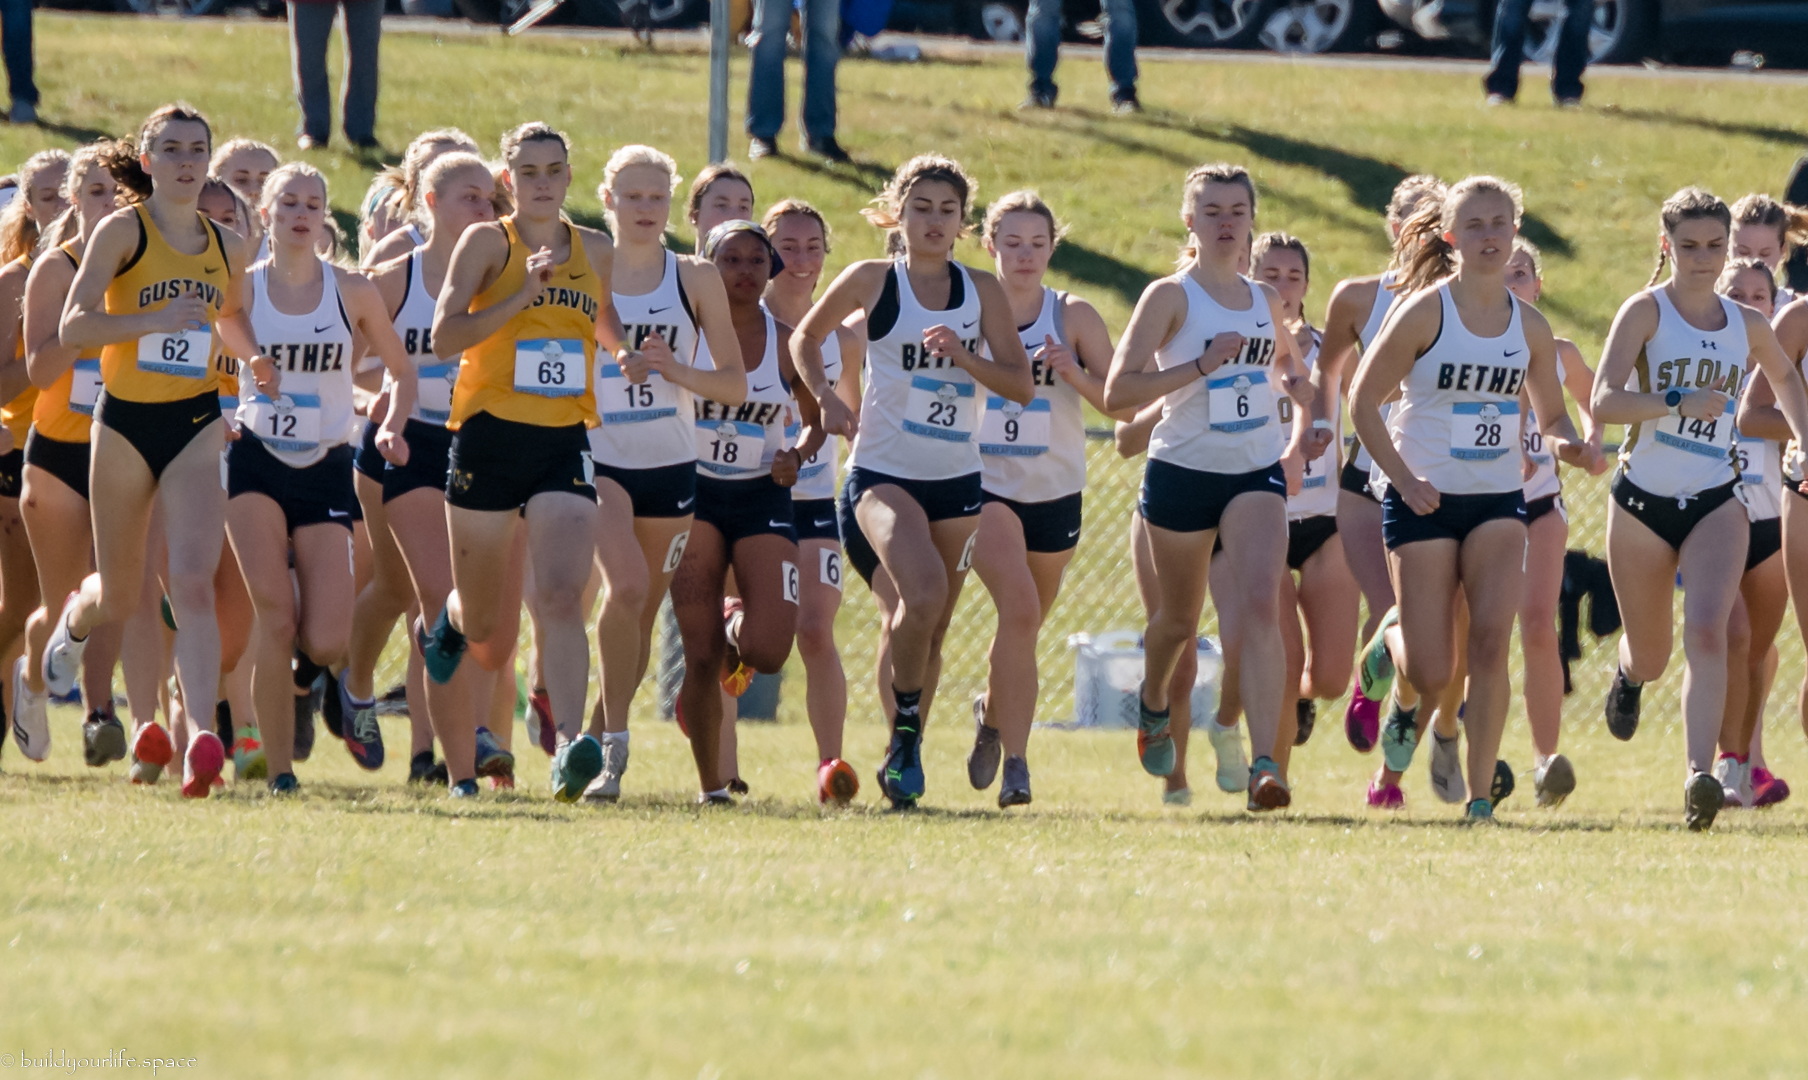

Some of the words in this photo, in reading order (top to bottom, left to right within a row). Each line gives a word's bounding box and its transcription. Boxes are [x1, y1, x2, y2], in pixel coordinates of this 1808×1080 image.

[138, 278, 225, 310] GUSTAVU
[162, 338, 189, 362] 62
[259, 343, 343, 371] ETHEL
[538, 361, 565, 384] 63
[1695, 358, 1746, 399] OLA
[624, 384, 654, 408] 15
[1236, 395, 1249, 417] 6
[268, 413, 297, 438] 12
[696, 399, 781, 426] ETHEL
[926, 401, 957, 427] 23
[1004, 419, 1019, 442] 9
[1475, 424, 1502, 446] 28
[1678, 416, 1718, 442] 144
[710, 440, 738, 463] 18
[670, 534, 686, 569] 6
[827, 553, 840, 585] 6
[788, 567, 798, 600] 6
